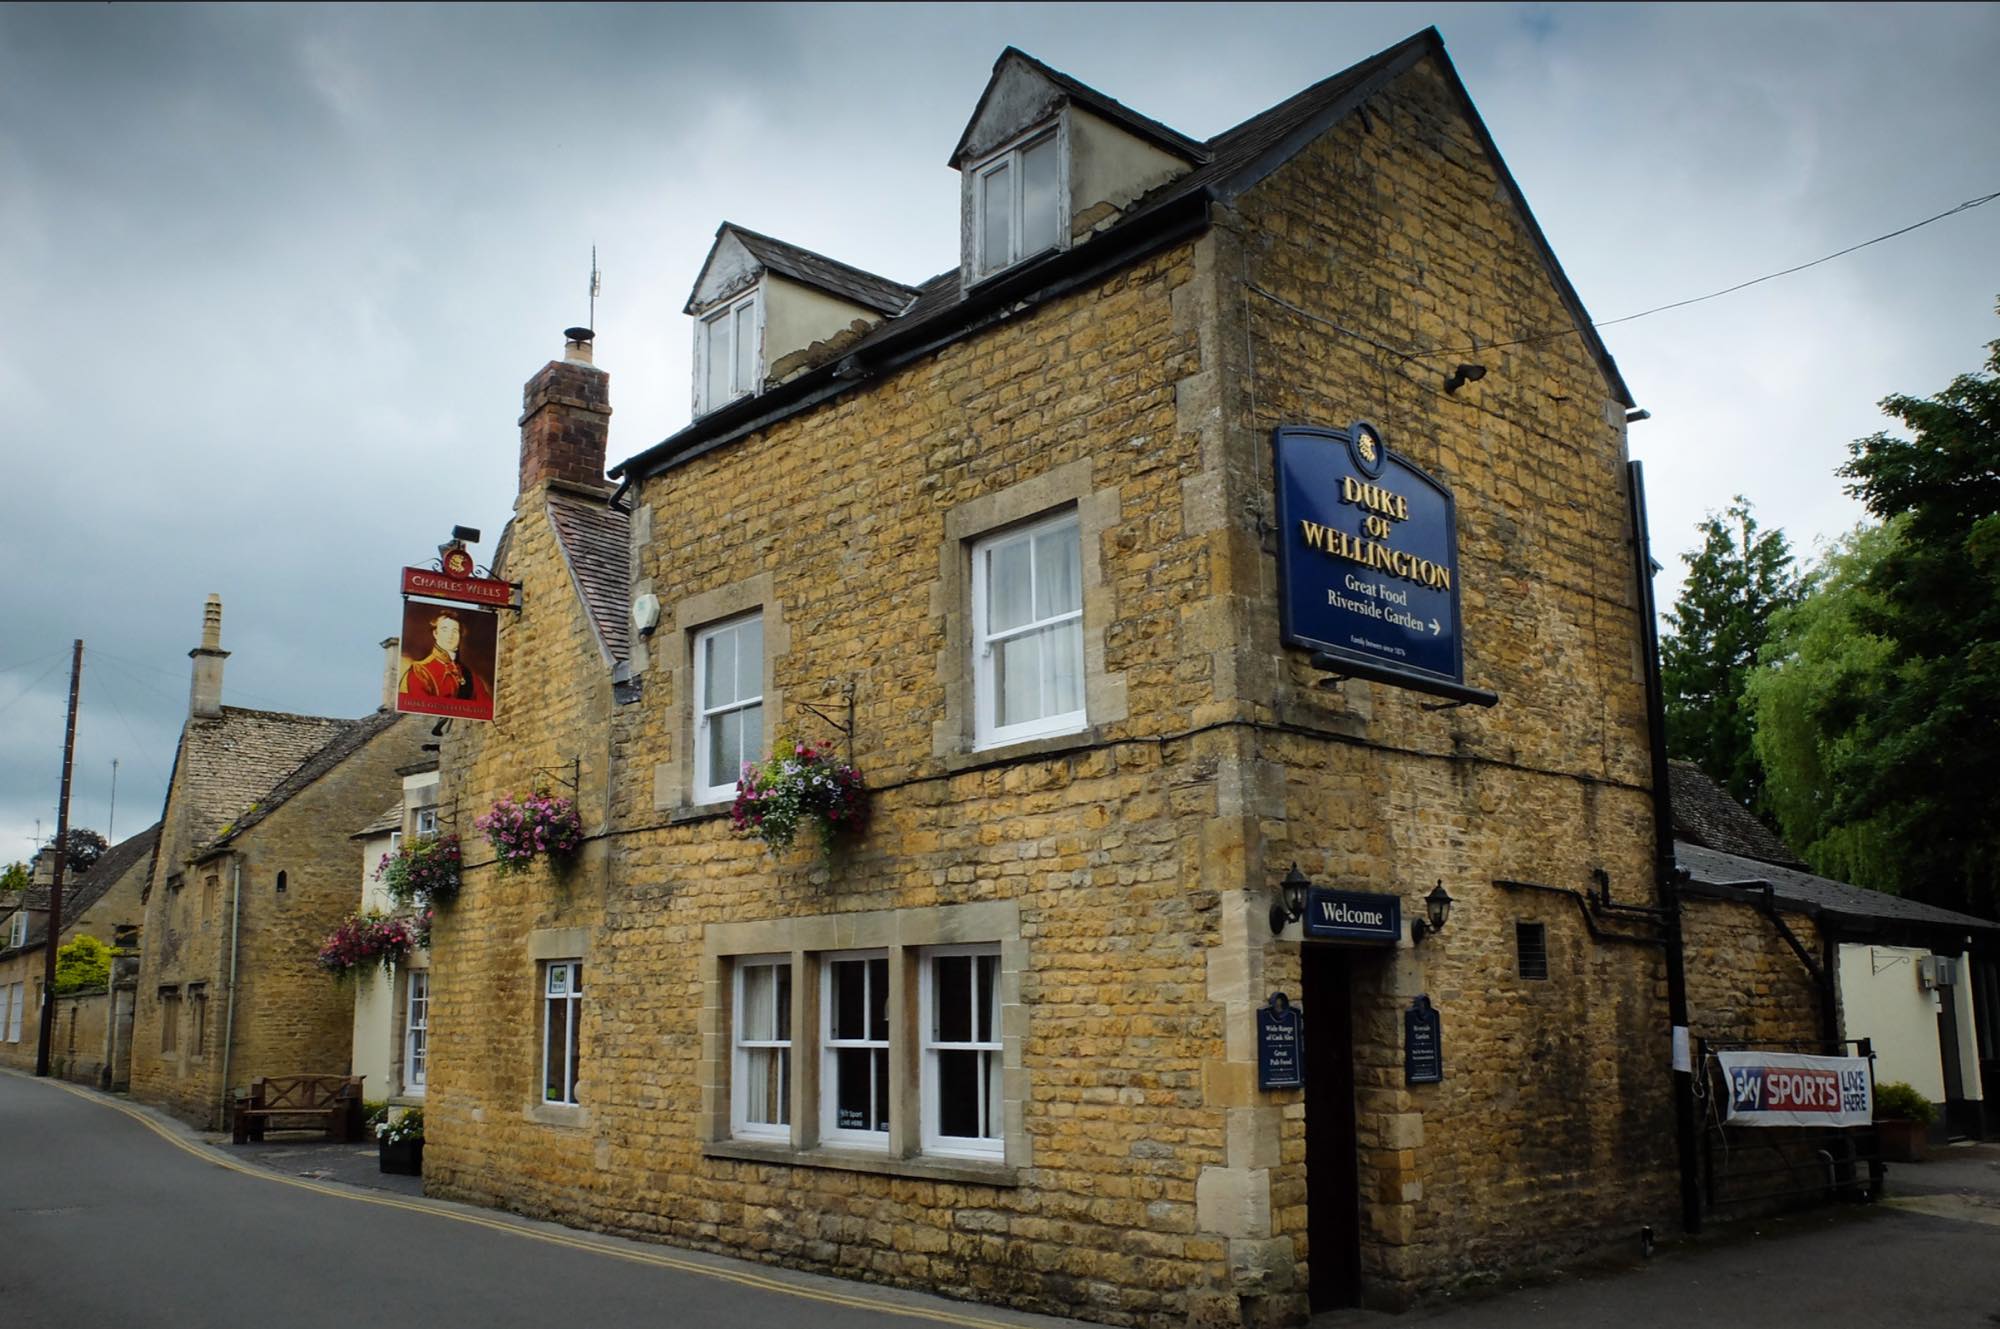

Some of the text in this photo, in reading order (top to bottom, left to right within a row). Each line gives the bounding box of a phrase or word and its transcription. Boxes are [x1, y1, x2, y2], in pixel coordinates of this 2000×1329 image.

[1343, 476, 1408, 520] DUKE
[1366, 515, 1391, 539] OF
[1301, 519, 1451, 590] WELLINGTON
[411, 575, 501, 598] CHARLES WELLS
[1345, 574, 1407, 606] Great Food
[1327, 589, 1424, 631] Riverside Garden
[1321, 902, 1384, 926] Welcome
[1278, 1025, 1294, 1034] Range
[1736, 1068, 1839, 1109] sky SPORTS
[1841, 1071, 1865, 1093] LIVE
[1843, 1093, 1867, 1113] HERE
